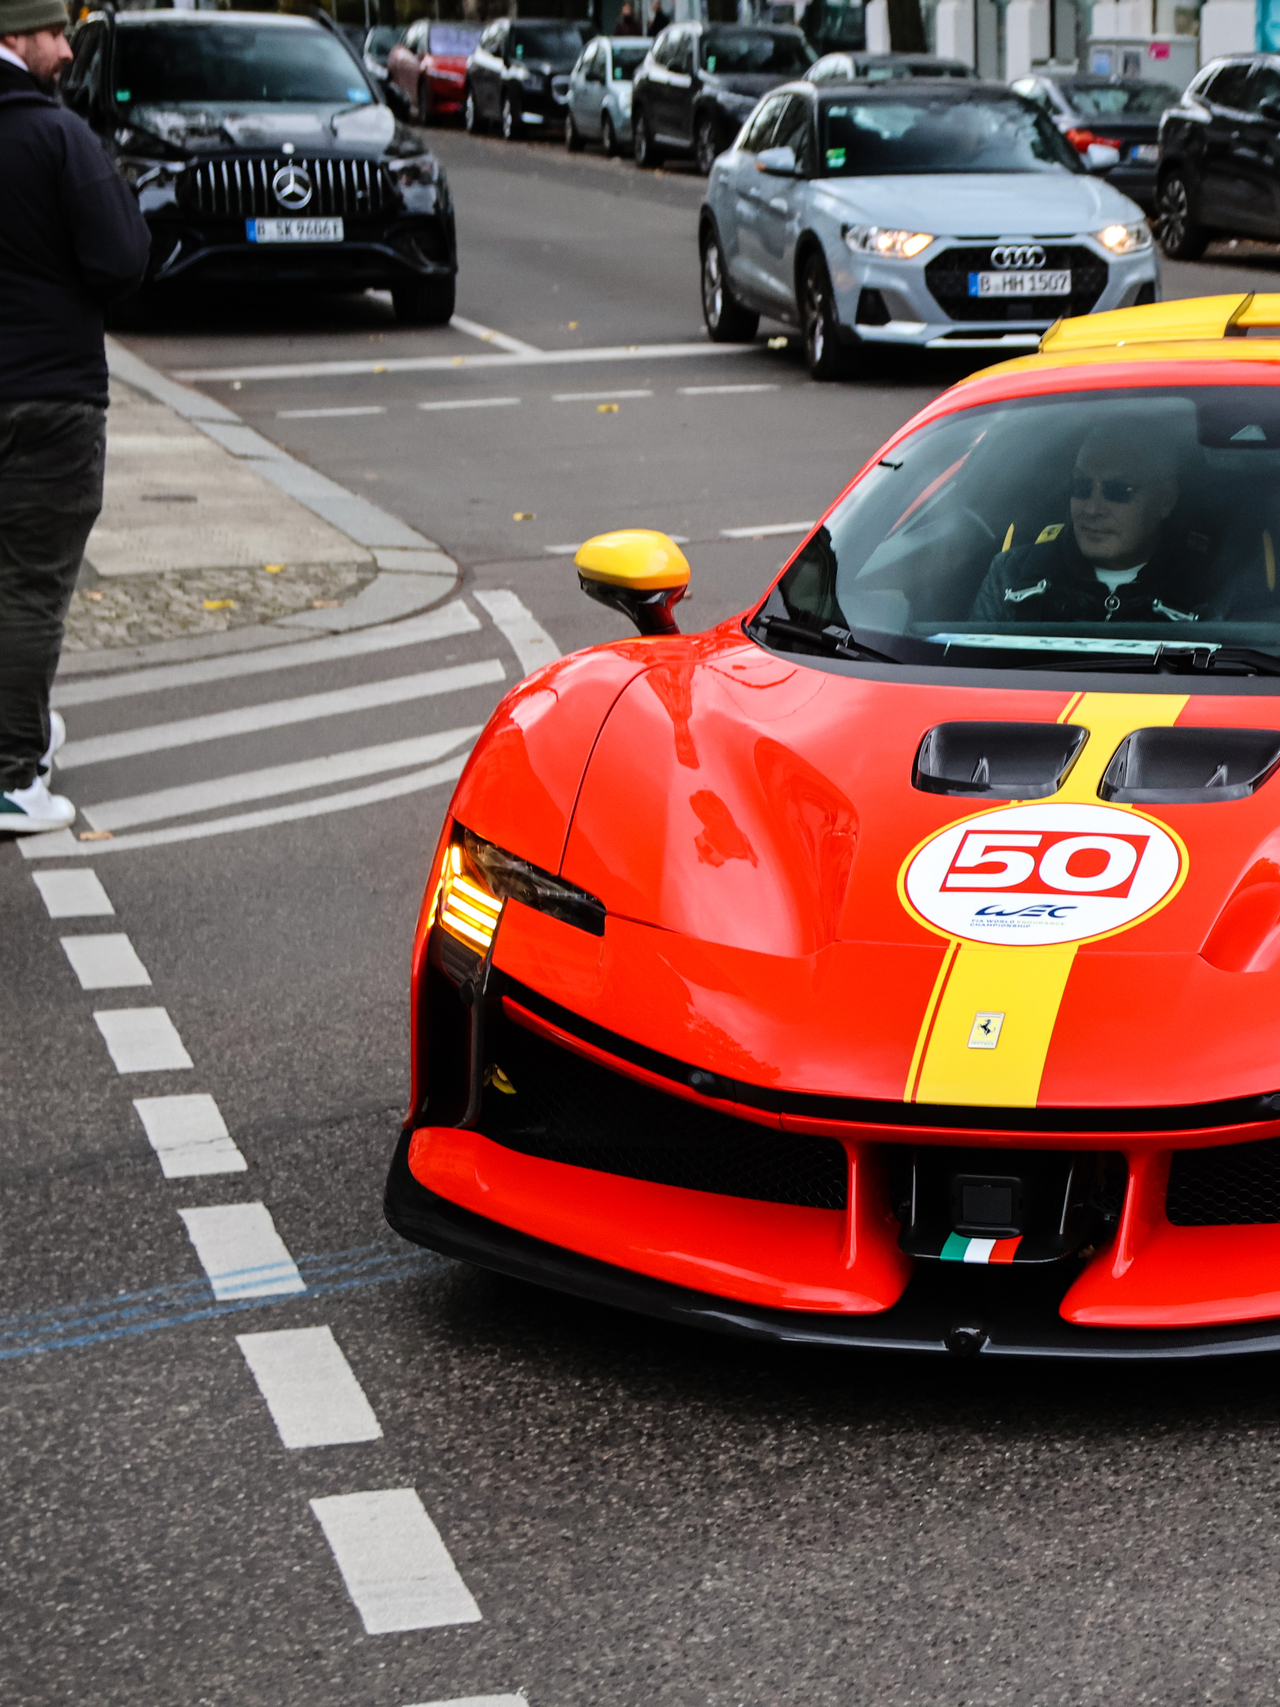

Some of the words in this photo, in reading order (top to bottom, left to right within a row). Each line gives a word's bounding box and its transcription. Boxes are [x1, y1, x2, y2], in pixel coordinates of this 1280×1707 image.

[980, 275, 990, 291] B
[1002, 274, 1024, 291] HH
[1028, 273, 1068, 291] 1507
[945, 834, 1138, 893] 50
[975, 904, 1079, 919] WEC
